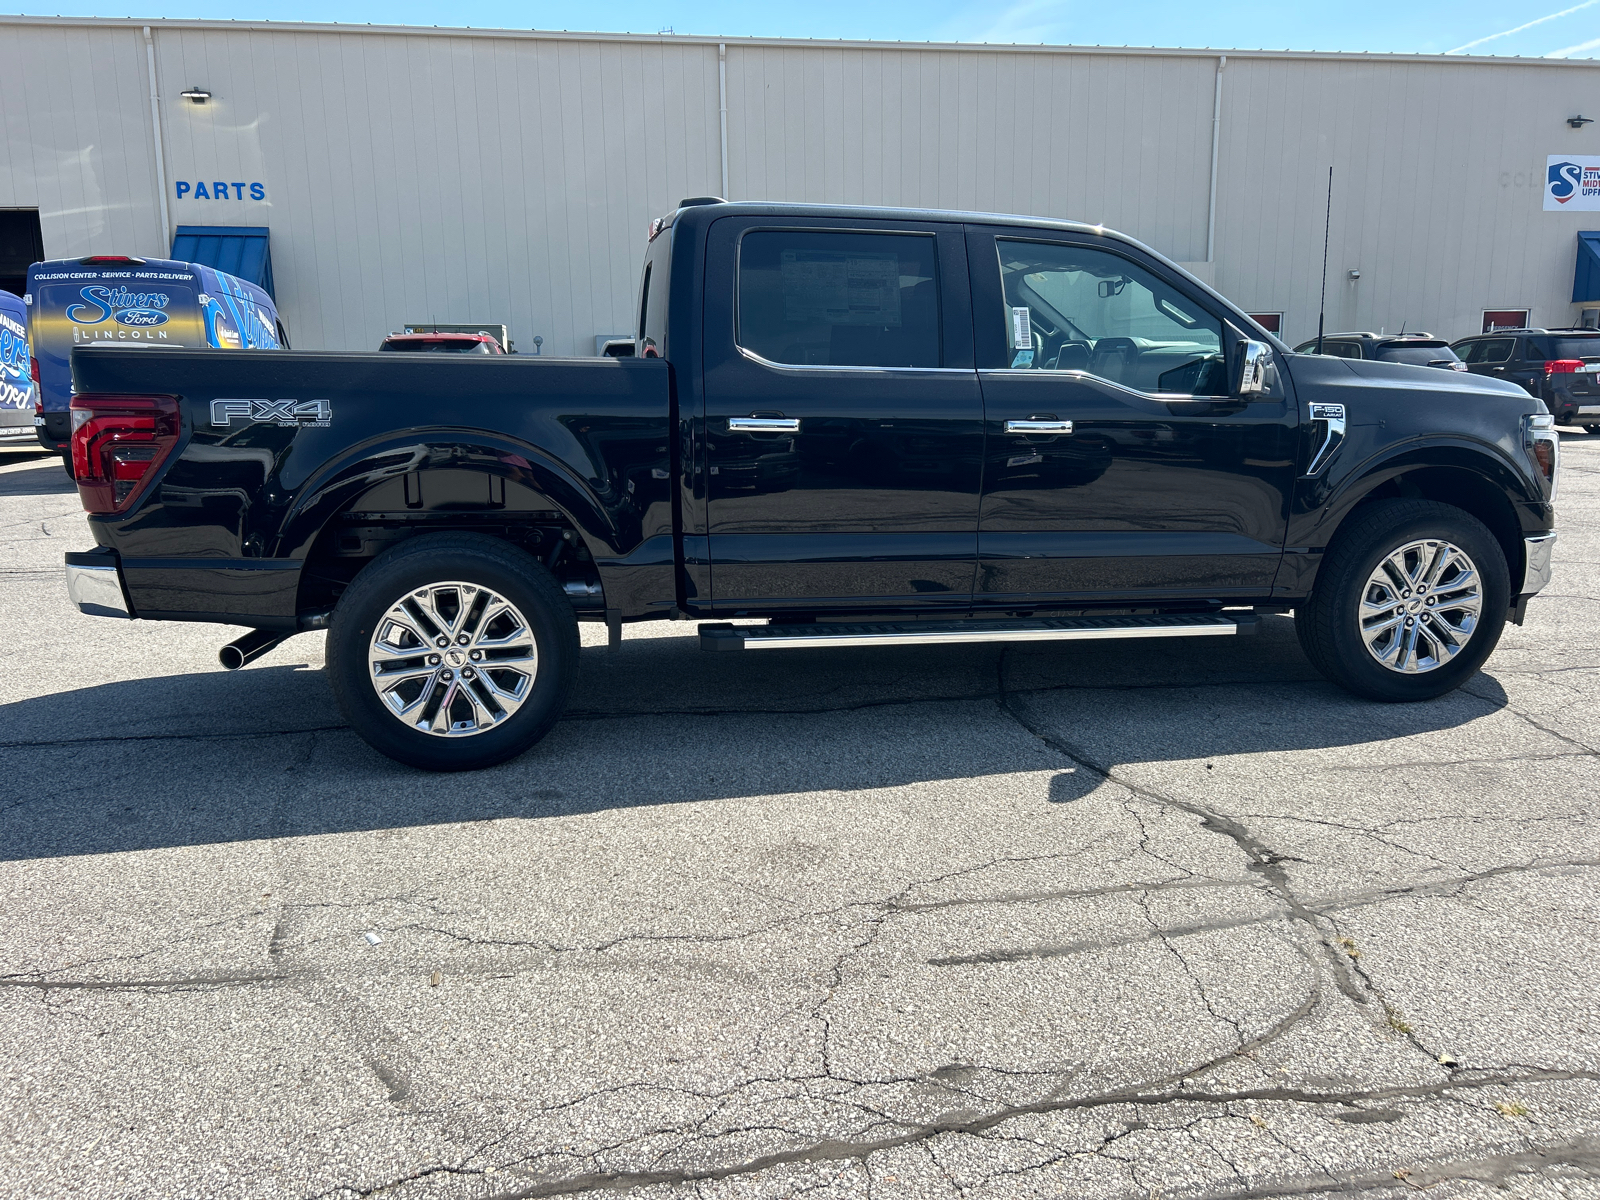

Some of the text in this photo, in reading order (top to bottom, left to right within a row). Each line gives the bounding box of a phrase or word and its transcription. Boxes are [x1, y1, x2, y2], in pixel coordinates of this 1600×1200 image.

[176, 181, 265, 201] PARTS
[34, 272, 69, 280] COLLISION
[101, 271, 131, 279] SERVICE
[66, 285, 169, 325] Stivers
[124, 310, 159, 324] Ford
[82, 330, 167, 339] LINCOLN
[210, 398, 332, 426] FX4
[1313, 405, 1343, 413] F-150
